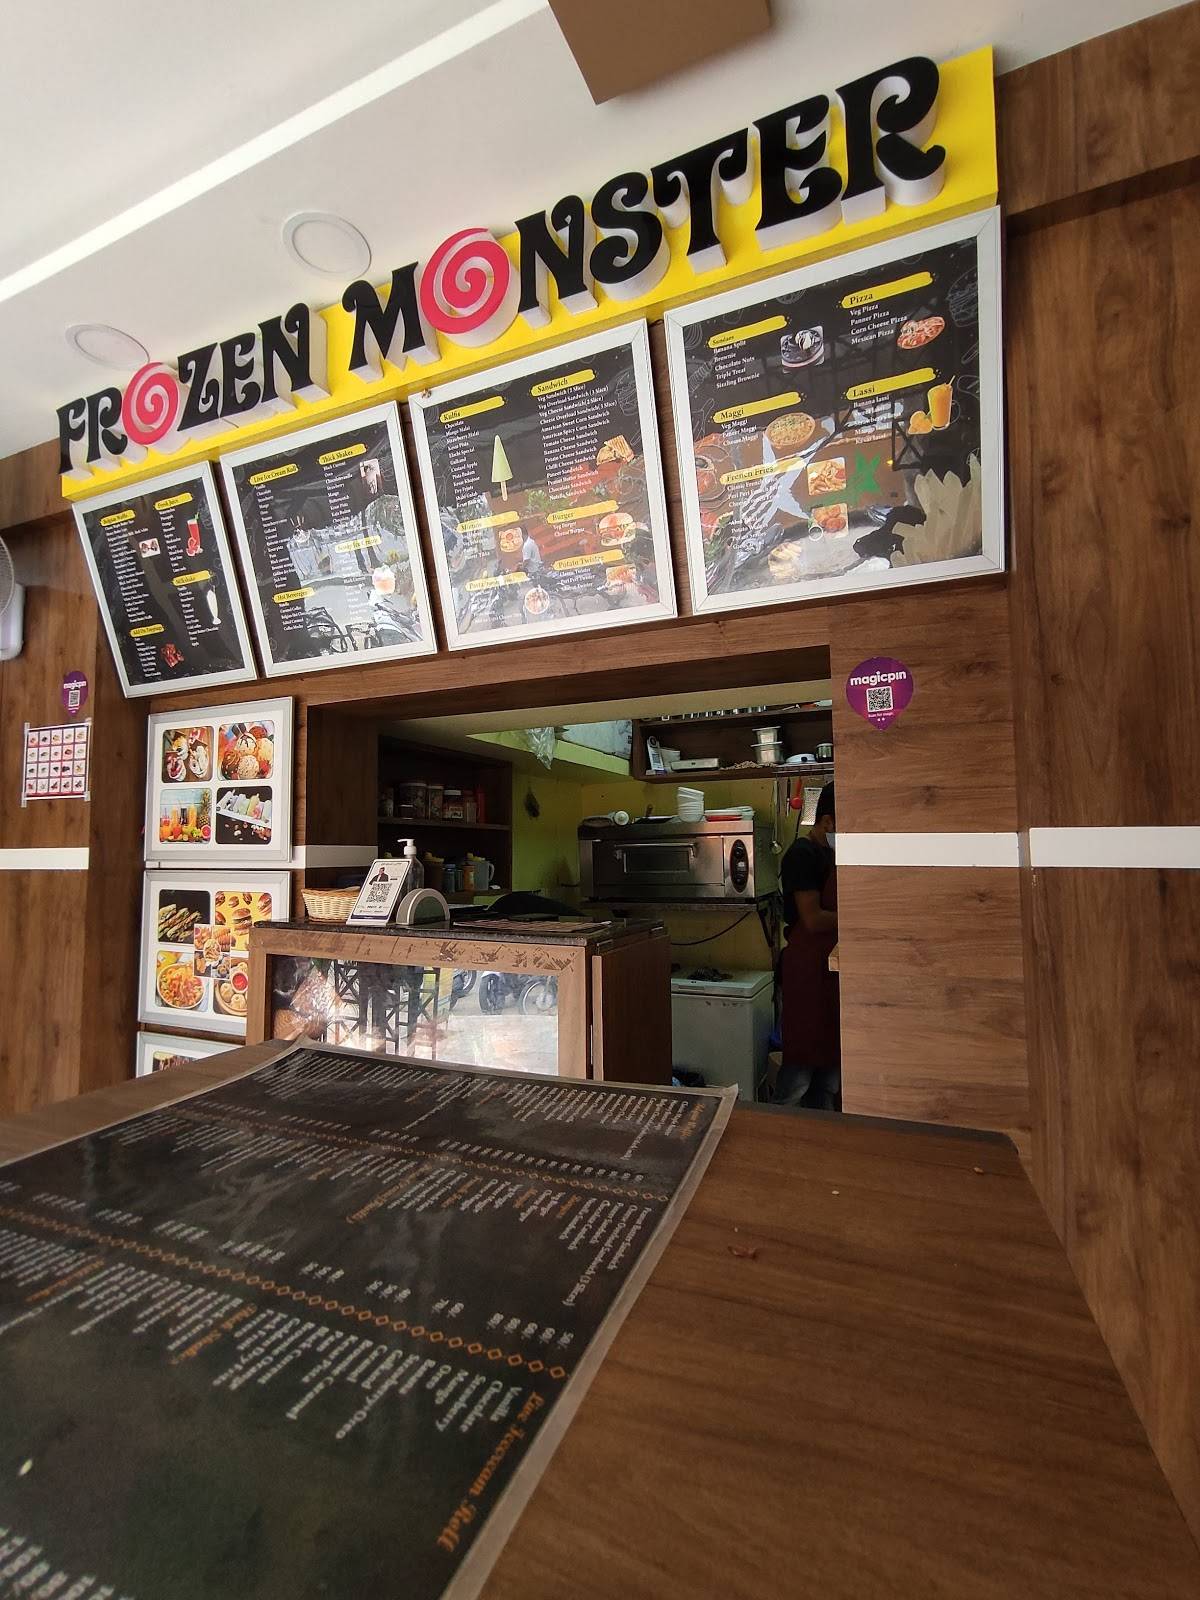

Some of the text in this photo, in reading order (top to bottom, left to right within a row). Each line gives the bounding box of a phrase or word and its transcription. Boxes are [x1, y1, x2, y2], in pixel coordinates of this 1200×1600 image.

[57, 56, 944, 474] FROZEN MONSTER
[850, 293, 872, 304] Pizza
[862, 304, 877, 312] Pizza
[873, 310, 888, 318] Pizza
[851, 315, 906, 334] Corn Cheese Pizza
[851, 334, 875, 343] Mexican
[713, 340, 745, 353] Banana Split
[714, 353, 735, 362] Brownie
[715, 361, 740, 370] Chocolate
[716, 371, 730, 379] Triple
[716, 372, 759, 388] Sizzling Brownie
[537, 378, 567, 391] Sandwich
[853, 386, 874, 396] Lassi
[546, 389, 566, 398] Sandwich
[567, 391, 588, 400] Sandwich
[588, 411, 609, 419] Sandwich
[721, 409, 743, 418] Maggi
[588, 419, 609, 427] Sandwich
[732, 418, 747, 426] Maggi
[576, 430, 596, 438] Sandwich
[576, 438, 597, 446] Sandwich
[575, 446, 596, 454] Sandwich
[574, 454, 595, 463] Sandwich
[562, 465, 582, 473] Sandwich
[577, 470, 598, 478] Sandwich
[727, 467, 773, 481] French Fries
[850, 671, 907, 686] magicpin
[585, 1247, 609, 1274] Sandwich
[607, 1242, 630, 1268] Sandwich
[211, 1298, 242, 1317] Black
[263, 1313, 287, 1329] Jack
[240, 1318, 299, 1363] Golden Dry
[317, 1330, 342, 1350] Paan
[229, 1322, 314, 1389] Brownie Orange
[258, 1326, 328, 1383] Black Current
[302, 1335, 357, 1382] Kesar Pista
[347, 1345, 387, 1381] Caramel
[286, 1340, 372, 1419] Brownie Caramel
[399, 1360, 434, 1393] Banana
[426, 1365, 451, 1388] Oreo
[435, 1370, 468, 1403] Mango
[436, 1375, 485, 1430] Strawberry
[461, 1381, 502, 1431] Chocolate
[490, 1387, 521, 1420] Vanilla
[516, 1392, 543, 1420] Live
[438, 1499, 475, 1550] Roll
